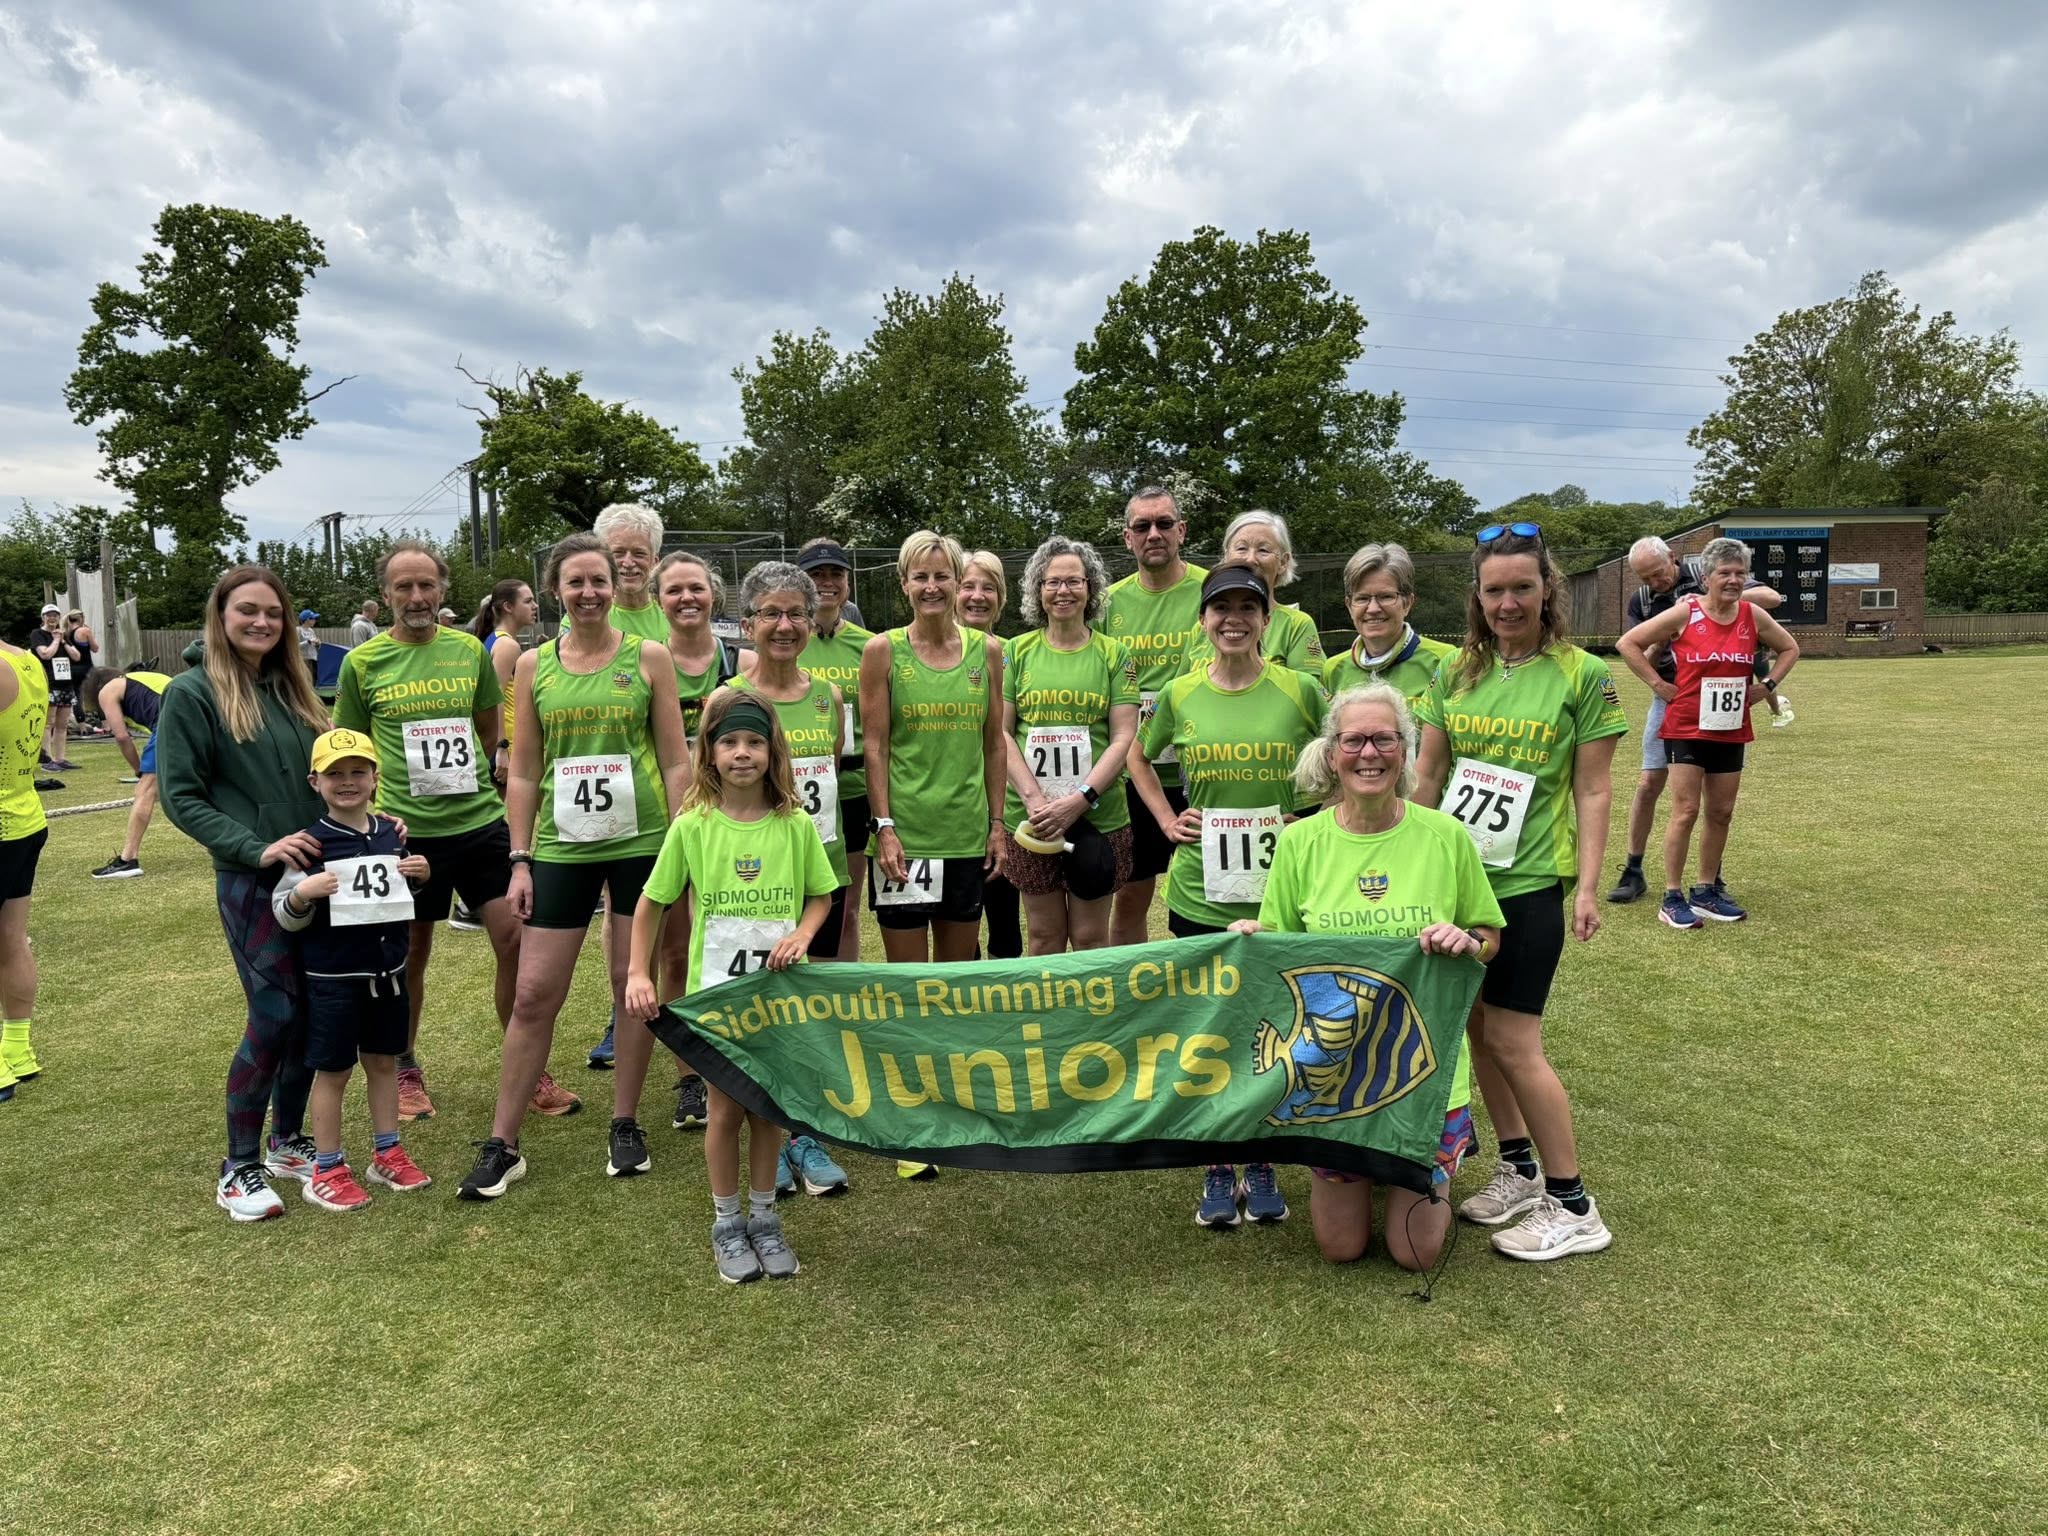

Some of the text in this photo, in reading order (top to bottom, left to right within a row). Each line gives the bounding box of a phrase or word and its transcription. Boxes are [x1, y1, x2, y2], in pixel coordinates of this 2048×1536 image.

[1800, 593, 1817, 601] OVERS
[375, 677, 478, 702] SIDMOUTH
[1018, 689, 1110, 710] SIDMOUTH
[902, 703, 984, 718] SIDMOUTH
[1712, 691, 1742, 712] 185
[543, 705, 635, 724] SIDMOUTH
[411, 725, 467, 737] OTTERY 10K
[784, 729, 832, 743] MOUTH
[907, 723, 956, 732] RUNNING
[1443, 713, 1559, 744] SIDMOUTH
[1031, 733, 1084, 744] OTTERY 10K
[421, 737, 469, 769] 123
[1033, 746, 1080, 777] 211
[1185, 742, 1296, 765] SIDMOUTH
[1508, 745, 1550, 764] CLUB
[562, 763, 624, 776] OTTERY 10K
[813, 764, 829, 774] 10K
[1258, 768, 1286, 781] CLU
[1462, 769, 1524, 793] OTTERY 10K
[574, 778, 613, 813] 45
[804, 780, 821, 815] 3
[1452, 784, 1514, 832] 275
[1211, 816, 1277, 828] OTTERY 10K
[1219, 832, 1276, 871] 113
[353, 863, 390, 898] 43
[702, 887, 793, 907] SIDMOUTH
[763, 905, 791, 915] CLUB
[1319, 906, 1433, 929] SIDMOUTH
[728, 949, 771, 977] 47
[696, 954, 1241, 1040] Sidmouth Running Club
[823, 1023, 1232, 1118] Juniors
